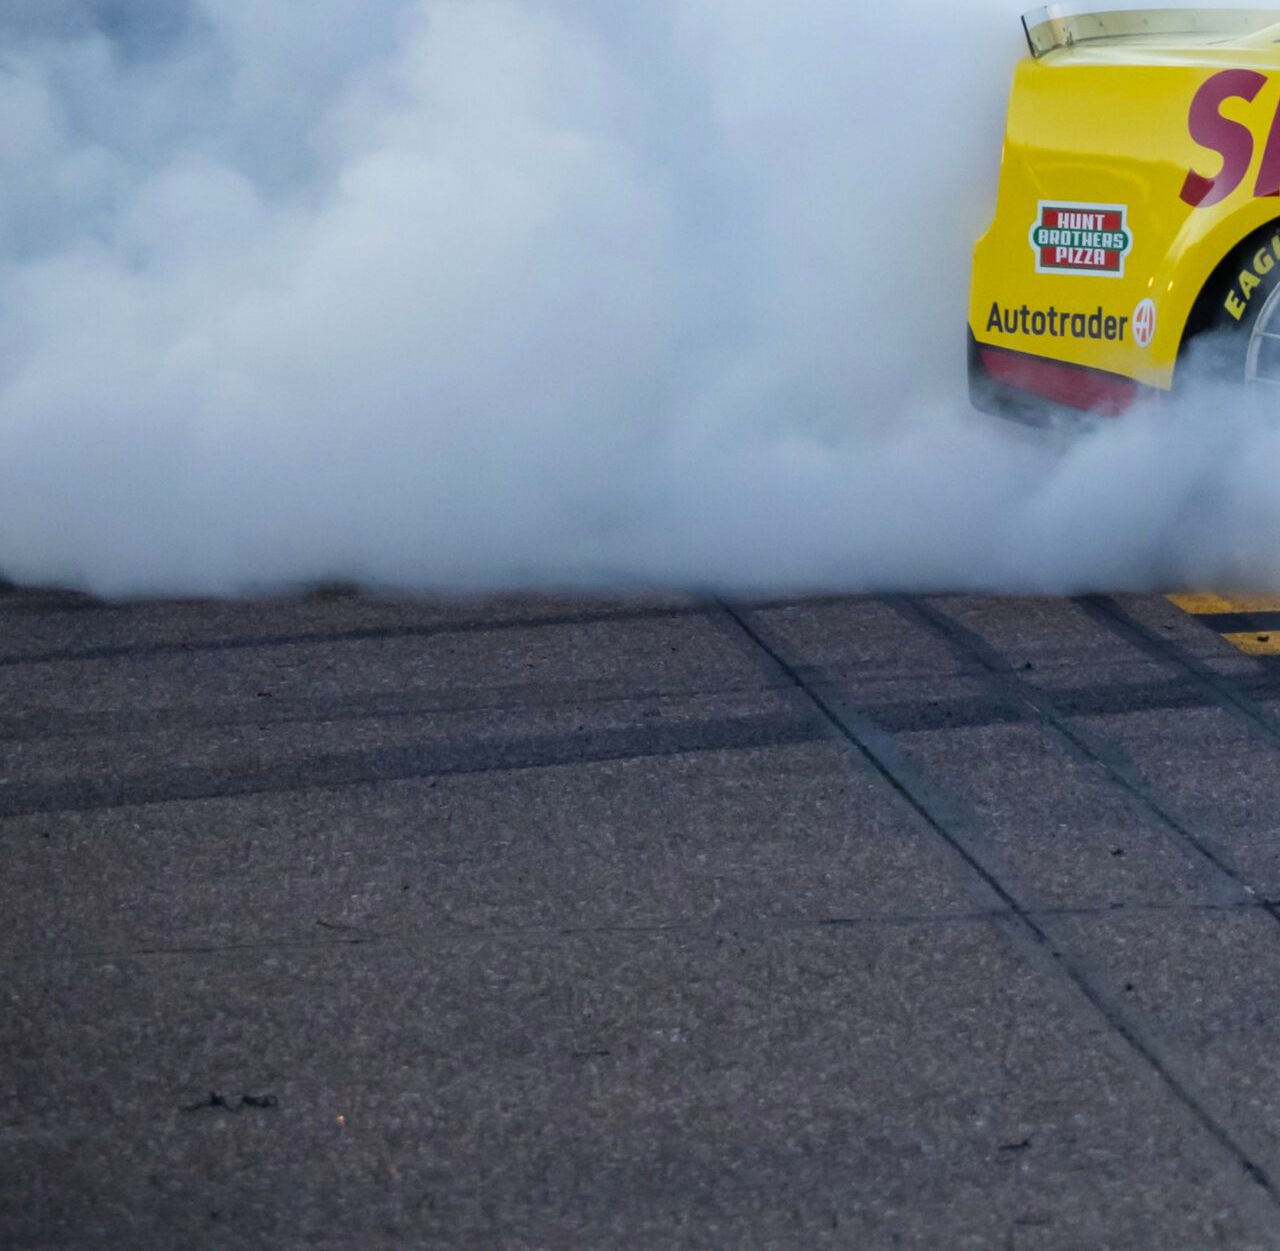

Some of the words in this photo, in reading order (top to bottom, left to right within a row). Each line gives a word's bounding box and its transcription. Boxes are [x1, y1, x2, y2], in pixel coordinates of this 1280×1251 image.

[1056, 211, 1105, 231] HUNT
[1037, 228, 1124, 249] BROTHERS
[1055, 246, 1106, 266] PIZZA
[985, 301, 1128, 341] Autotrader
